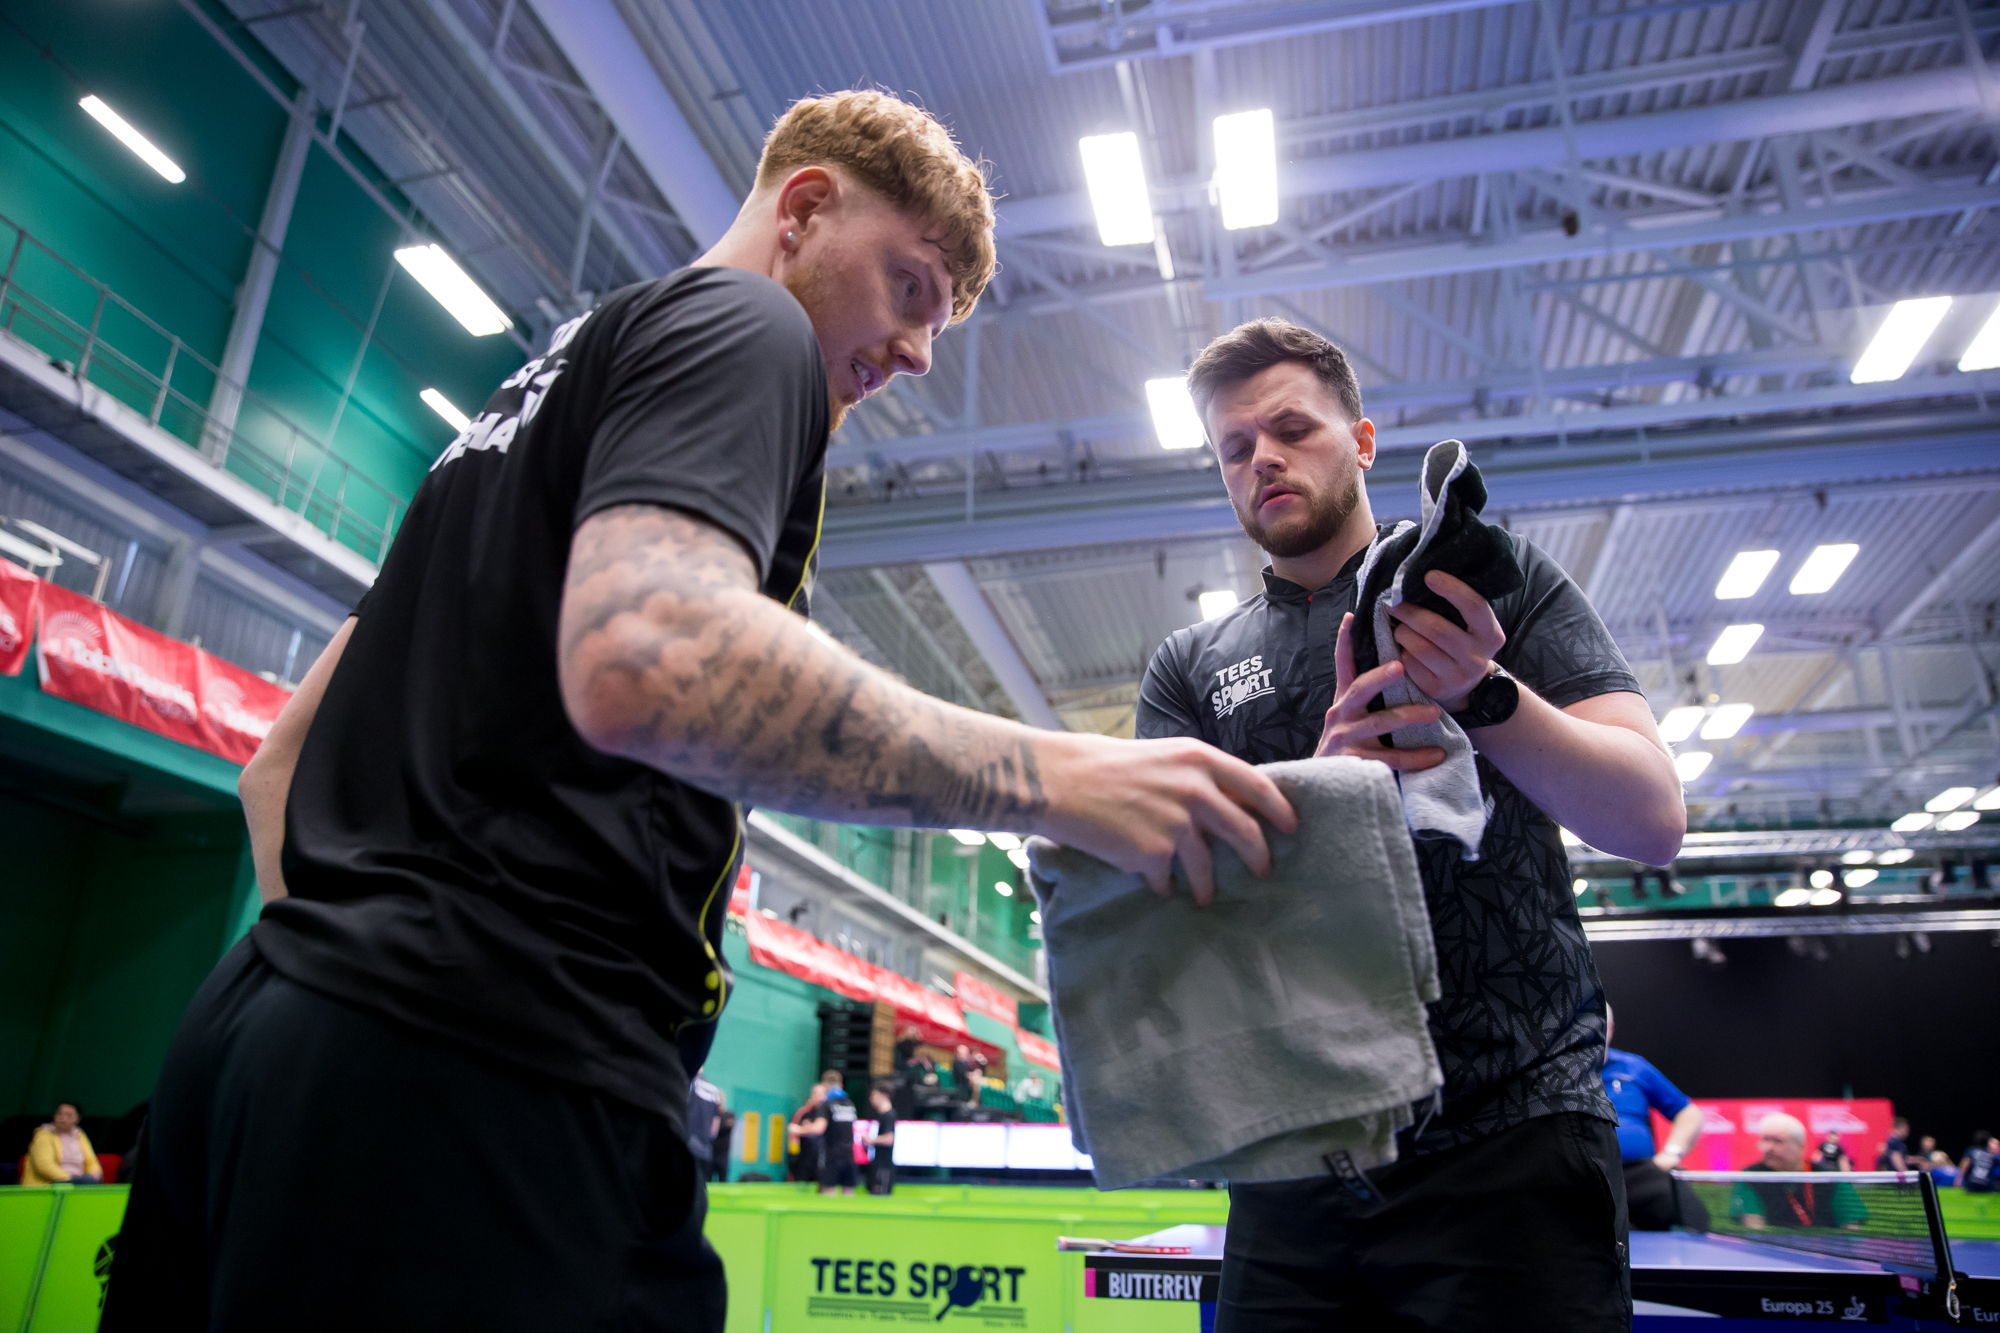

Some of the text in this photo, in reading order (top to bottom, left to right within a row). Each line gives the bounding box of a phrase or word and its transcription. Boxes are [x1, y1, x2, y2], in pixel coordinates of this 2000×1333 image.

[1215, 655, 1263, 687] TEES
[1211, 668, 1273, 712] SPORT
[811, 1258, 1026, 1308] TEES SPORT
[1108, 1272, 1203, 1301] BUTTERFLY
[1760, 1297, 1835, 1316] Europa 25
[1973, 1307, 2000, 1323] Eur
